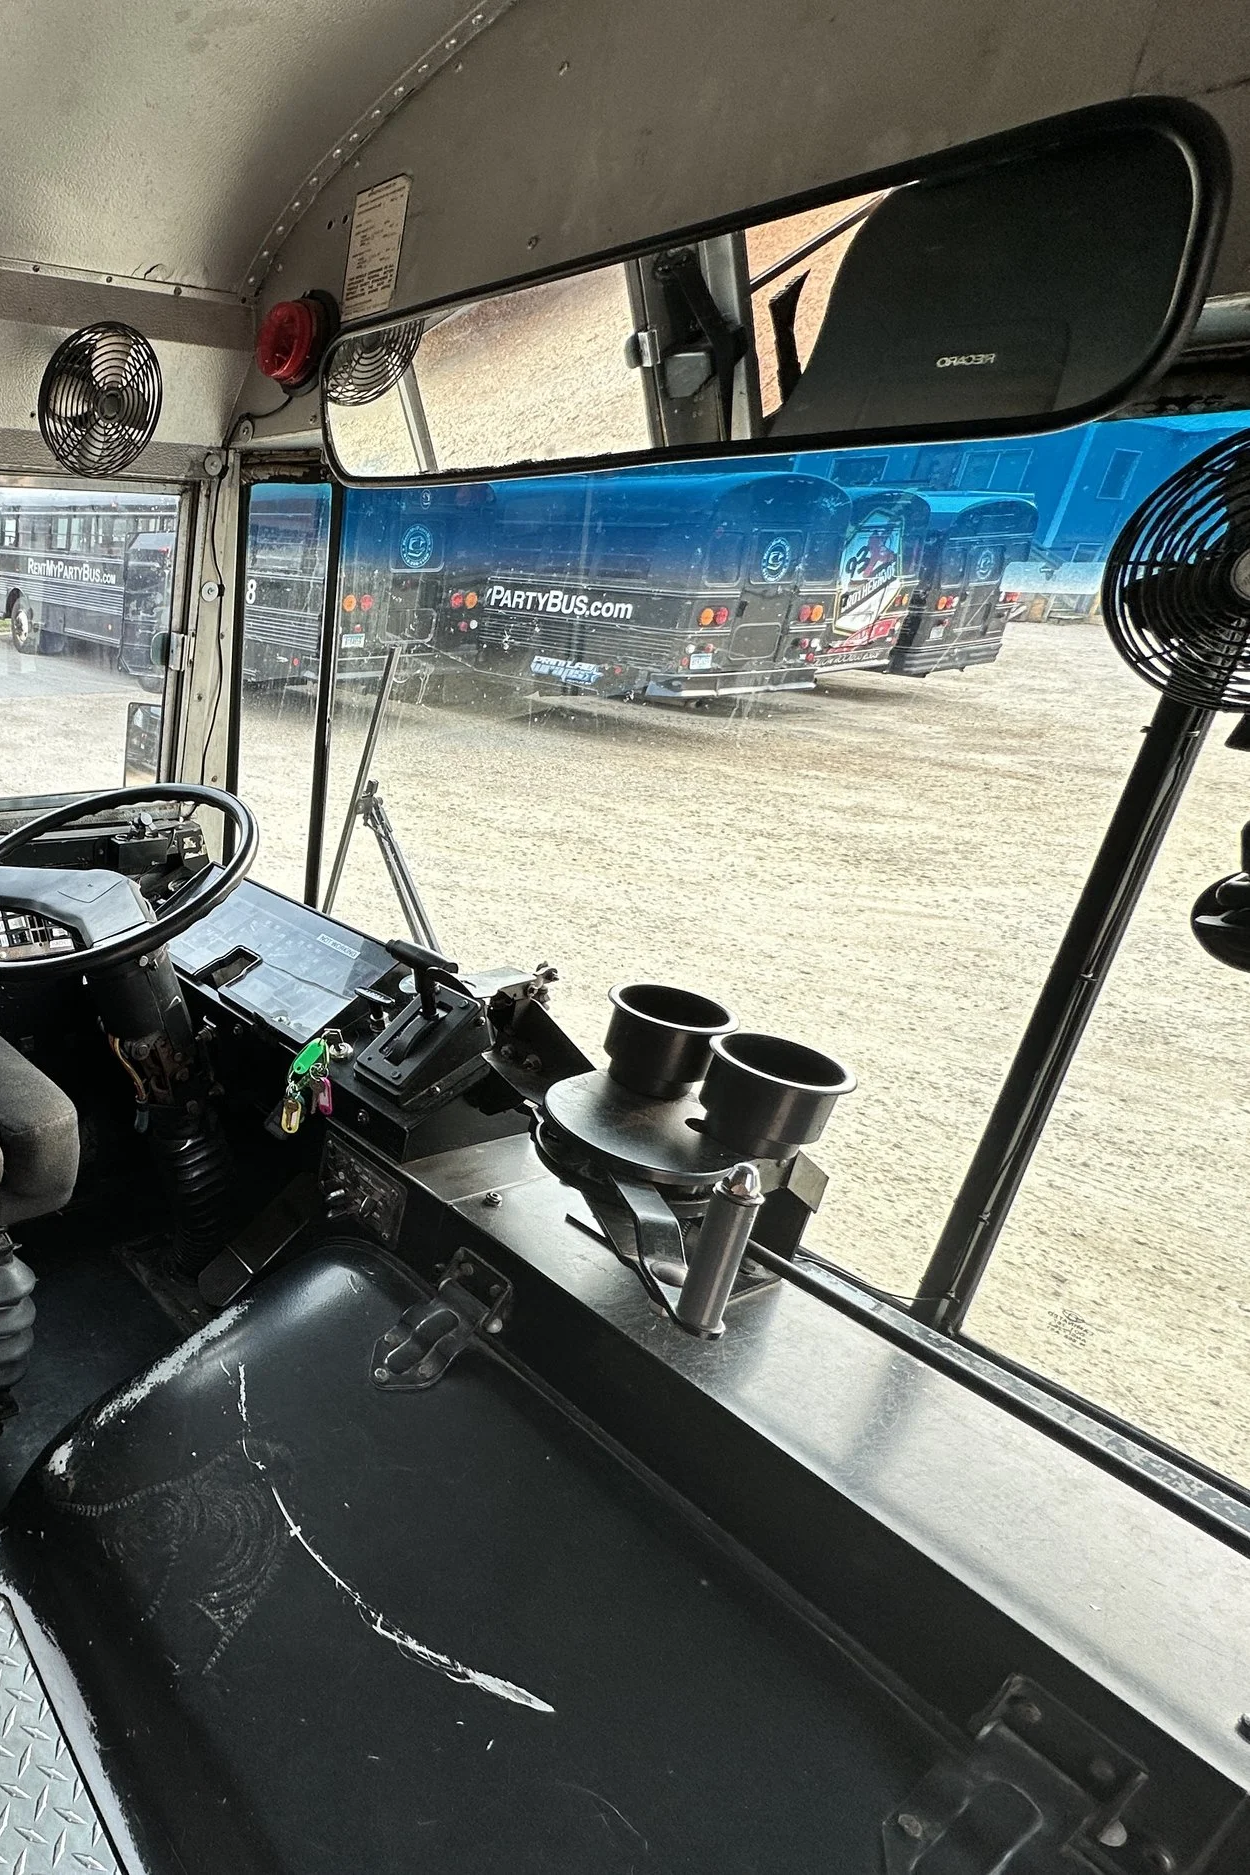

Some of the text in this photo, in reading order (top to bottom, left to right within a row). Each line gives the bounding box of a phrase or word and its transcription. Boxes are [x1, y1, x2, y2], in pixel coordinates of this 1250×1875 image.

[245, 579, 257, 605] 8
[320, 935, 358, 957] NOT WORKING
